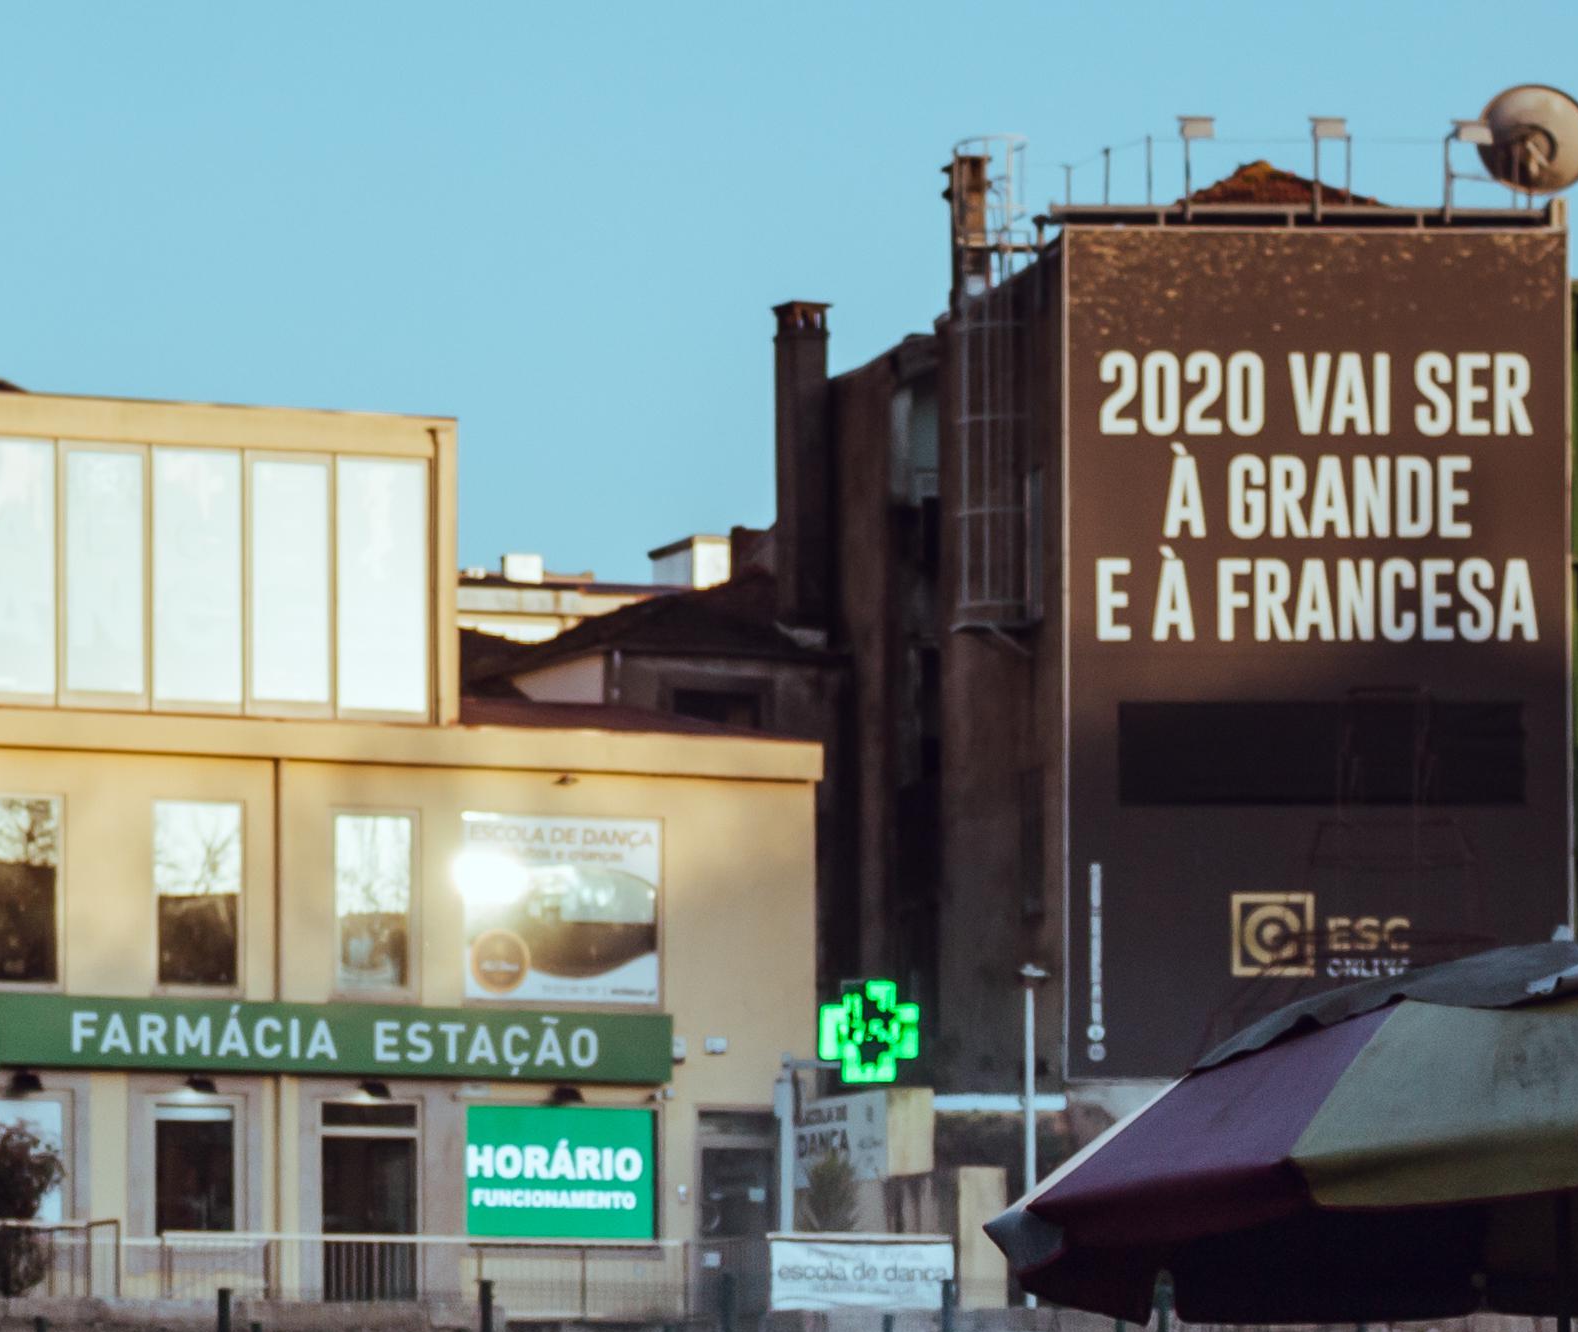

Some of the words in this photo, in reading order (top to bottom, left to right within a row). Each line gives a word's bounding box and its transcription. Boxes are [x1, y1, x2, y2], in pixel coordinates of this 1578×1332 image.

[1099, 350, 1265, 436] 2020
[1289, 352, 1391, 436] VAI
[1414, 352, 1534, 436] SER
[1163, 442, 1207, 539] À
[1228, 455, 1472, 539] GRANDE
[1096, 558, 1131, 642] E
[1152, 546, 1195, 642] À
[1218, 558, 1539, 642] FRANCESA
[550, 827, 577, 845] DE
[582, 828, 653, 850] DANÇA
[1326, 916, 1410, 951] ESC
[70, 1004, 339, 1061] FARMÁCIA
[373, 1016, 600, 1075] ESTAÇÃO
[467, 1138, 643, 1182] HORÁRIO
[472, 1188, 637, 1210] FUNCIONAMENTO
[778, 1261, 847, 1281] escola
[852, 1261, 878, 1281] de
